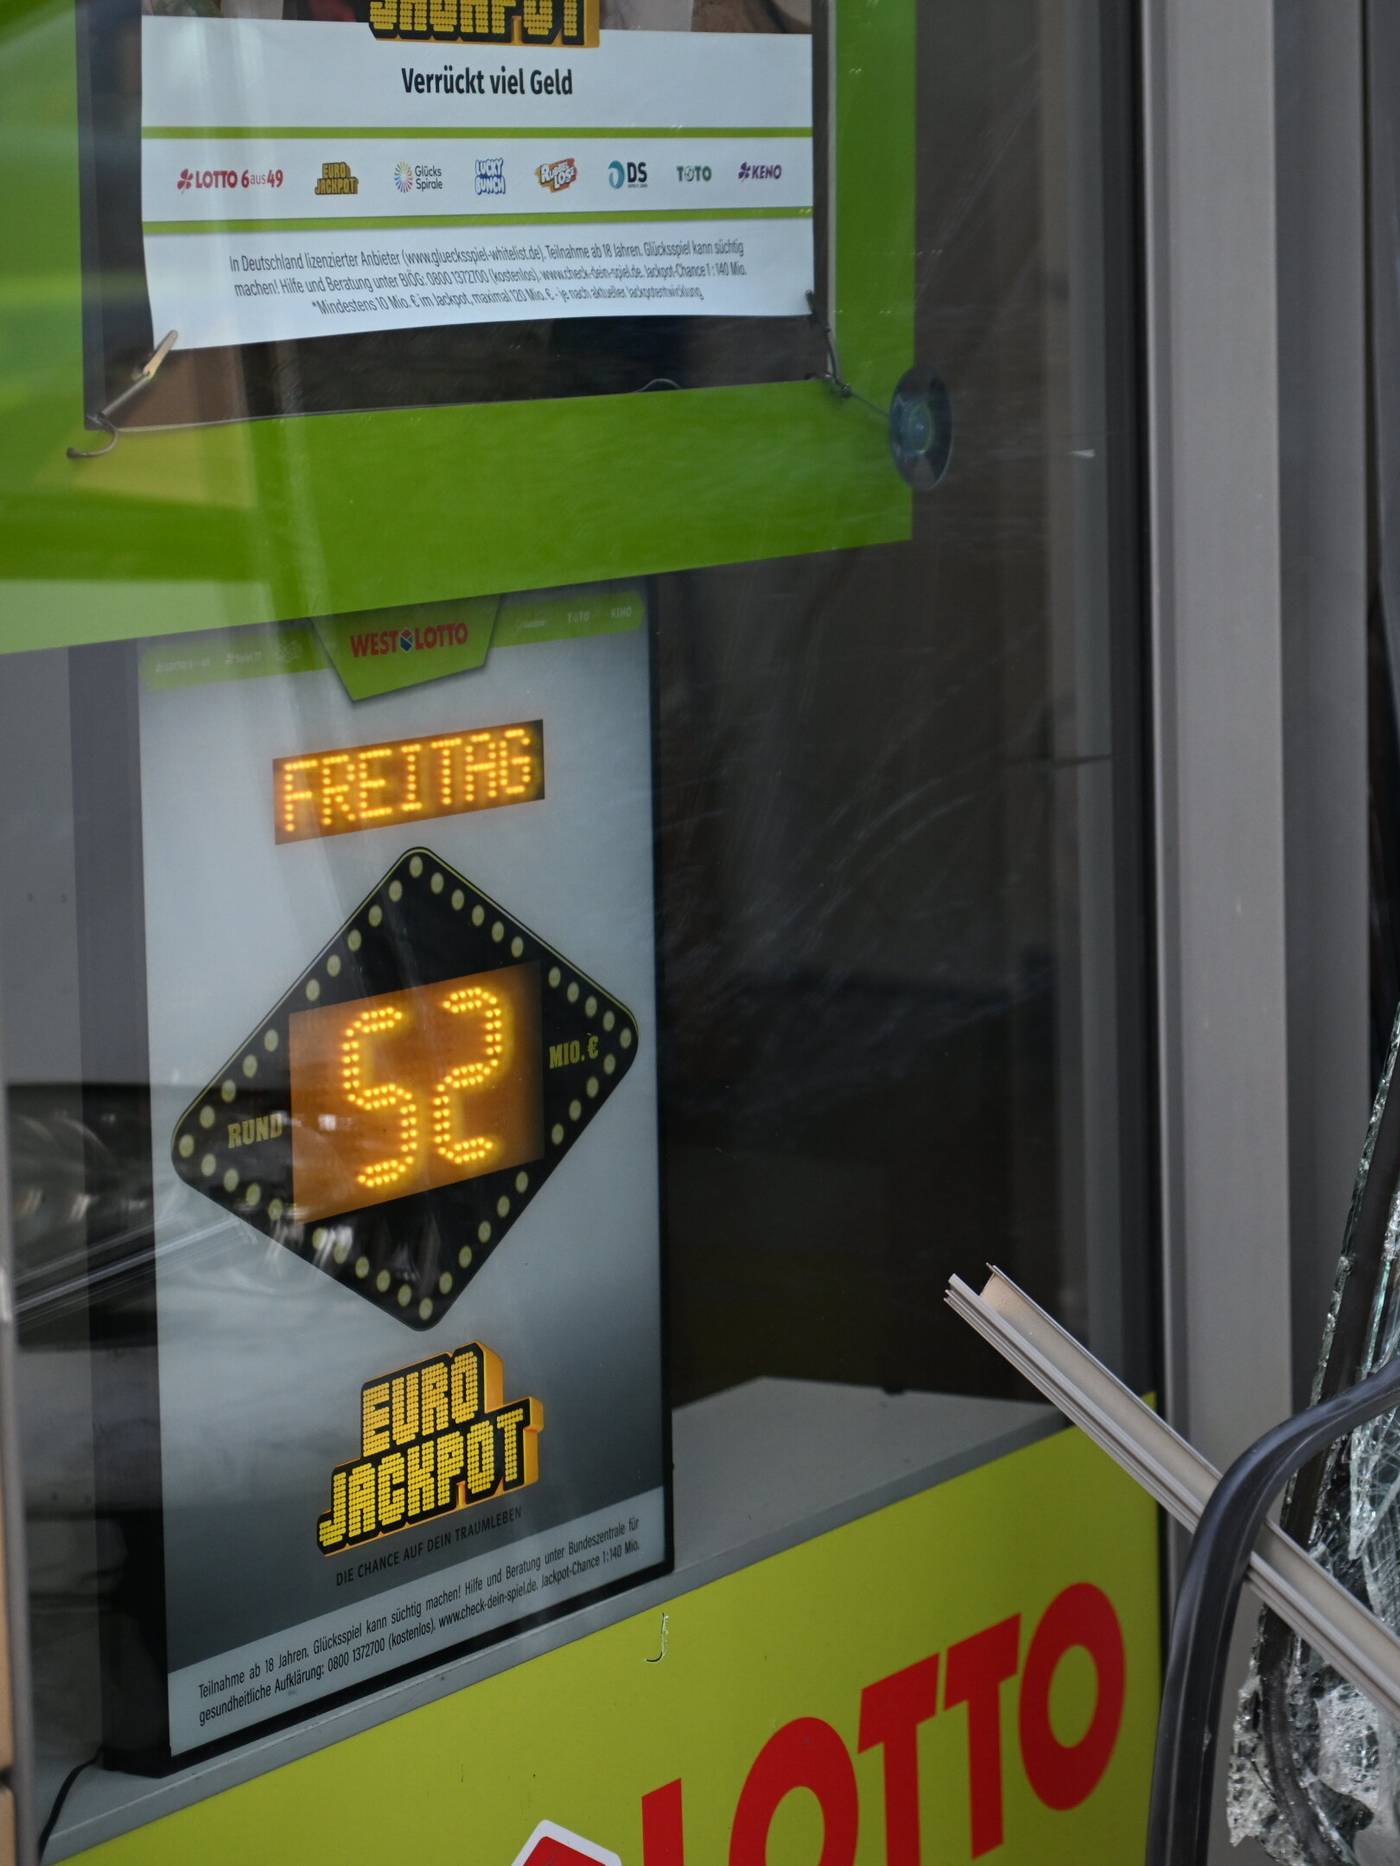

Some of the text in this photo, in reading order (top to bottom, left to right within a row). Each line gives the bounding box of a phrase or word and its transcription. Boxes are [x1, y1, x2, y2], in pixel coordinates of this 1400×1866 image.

[401, 65, 573, 95] Verrückt viel Geld
[195, 170, 238, 189] LOTTO
[322, 162, 349, 179] EURO
[415, 165, 442, 177] Glücks
[475, 157, 504, 177] LUCKY
[626, 161, 648, 183] DS
[676, 165, 712, 182] TOTO
[751, 164, 782, 180] KENO
[315, 178, 358, 195] JACKPOT
[416, 178, 443, 191] Spirale
[475, 176, 506, 195] BUNCH
[229, 255, 240, 272] In
[241, 252, 304, 272] Deutschland
[304, 251, 359, 269] lizenzierter
[360, 249, 401, 267] Anbieter
[545, 244, 590, 260] Teilnahme
[590, 243, 602, 258] ab
[602, 243, 612, 258] 18
[613, 242, 643, 258] Jahren.
[643, 239, 691, 258] Glücksspiel
[691, 240, 714, 256] kann
[714, 238, 744, 257] süchtig
[234, 280, 280, 297] machen!
[280, 277, 304, 294] Hilfe
[305, 277, 325, 293] und
[325, 275, 374, 293] Beratung
[373, 274, 399, 289] unter
[426, 270, 453, 286] 0800
[451, 269, 489, 285] 1372700
[488, 267, 540, 286] (kostenlos).
[644, 262, 706, 281] Jackpot-Chance
[730, 260, 748, 276] Mio.
[375, 295, 389, 311] 10
[387, 294, 412, 310] Mio.
[410, 293, 420, 308] €
[418, 293, 433, 307] im
[432, 291, 474, 309] Jackpot,
[472, 288, 511, 305] maximal
[509, 287, 528, 303] 120
[525, 287, 545, 302] Mio.
[544, 287, 555, 301] €
[559, 287, 570, 303] je
[569, 286, 592, 300] nach
[350, 622, 468, 658] WEST LOTTO
[282, 728, 531, 832] FREITAG
[342, 987, 501, 1187] 52
[228, 1112, 283, 1149] RUND
[362, 1350, 479, 1458] EURO
[318, 1408, 525, 1547] JACKPOT
[336, 1506, 522, 1587] DIE CHANCE AUF DEIN TRAUMLEBEN
[198, 1516, 640, 1699] Teilnahme ab 18 Jahren. Glücksspiel kann süchtig machen! Hilfe und Beratung unter Bundeszentrale für
[199, 1683, 271, 1727] gesundheitliche
[274, 1663, 325, 1695] Aufklärung:
[328, 1652, 349, 1673] 0800
[353, 1638, 386, 1662] 1372700
[388, 1619, 437, 1651] (kostenlos).
[438, 1578, 539, 1629] www.check-dein-spiel.de.
[541, 1555, 600, 1589] Jackpot-Chance
[624, 1540, 640, 1554] Mio.
